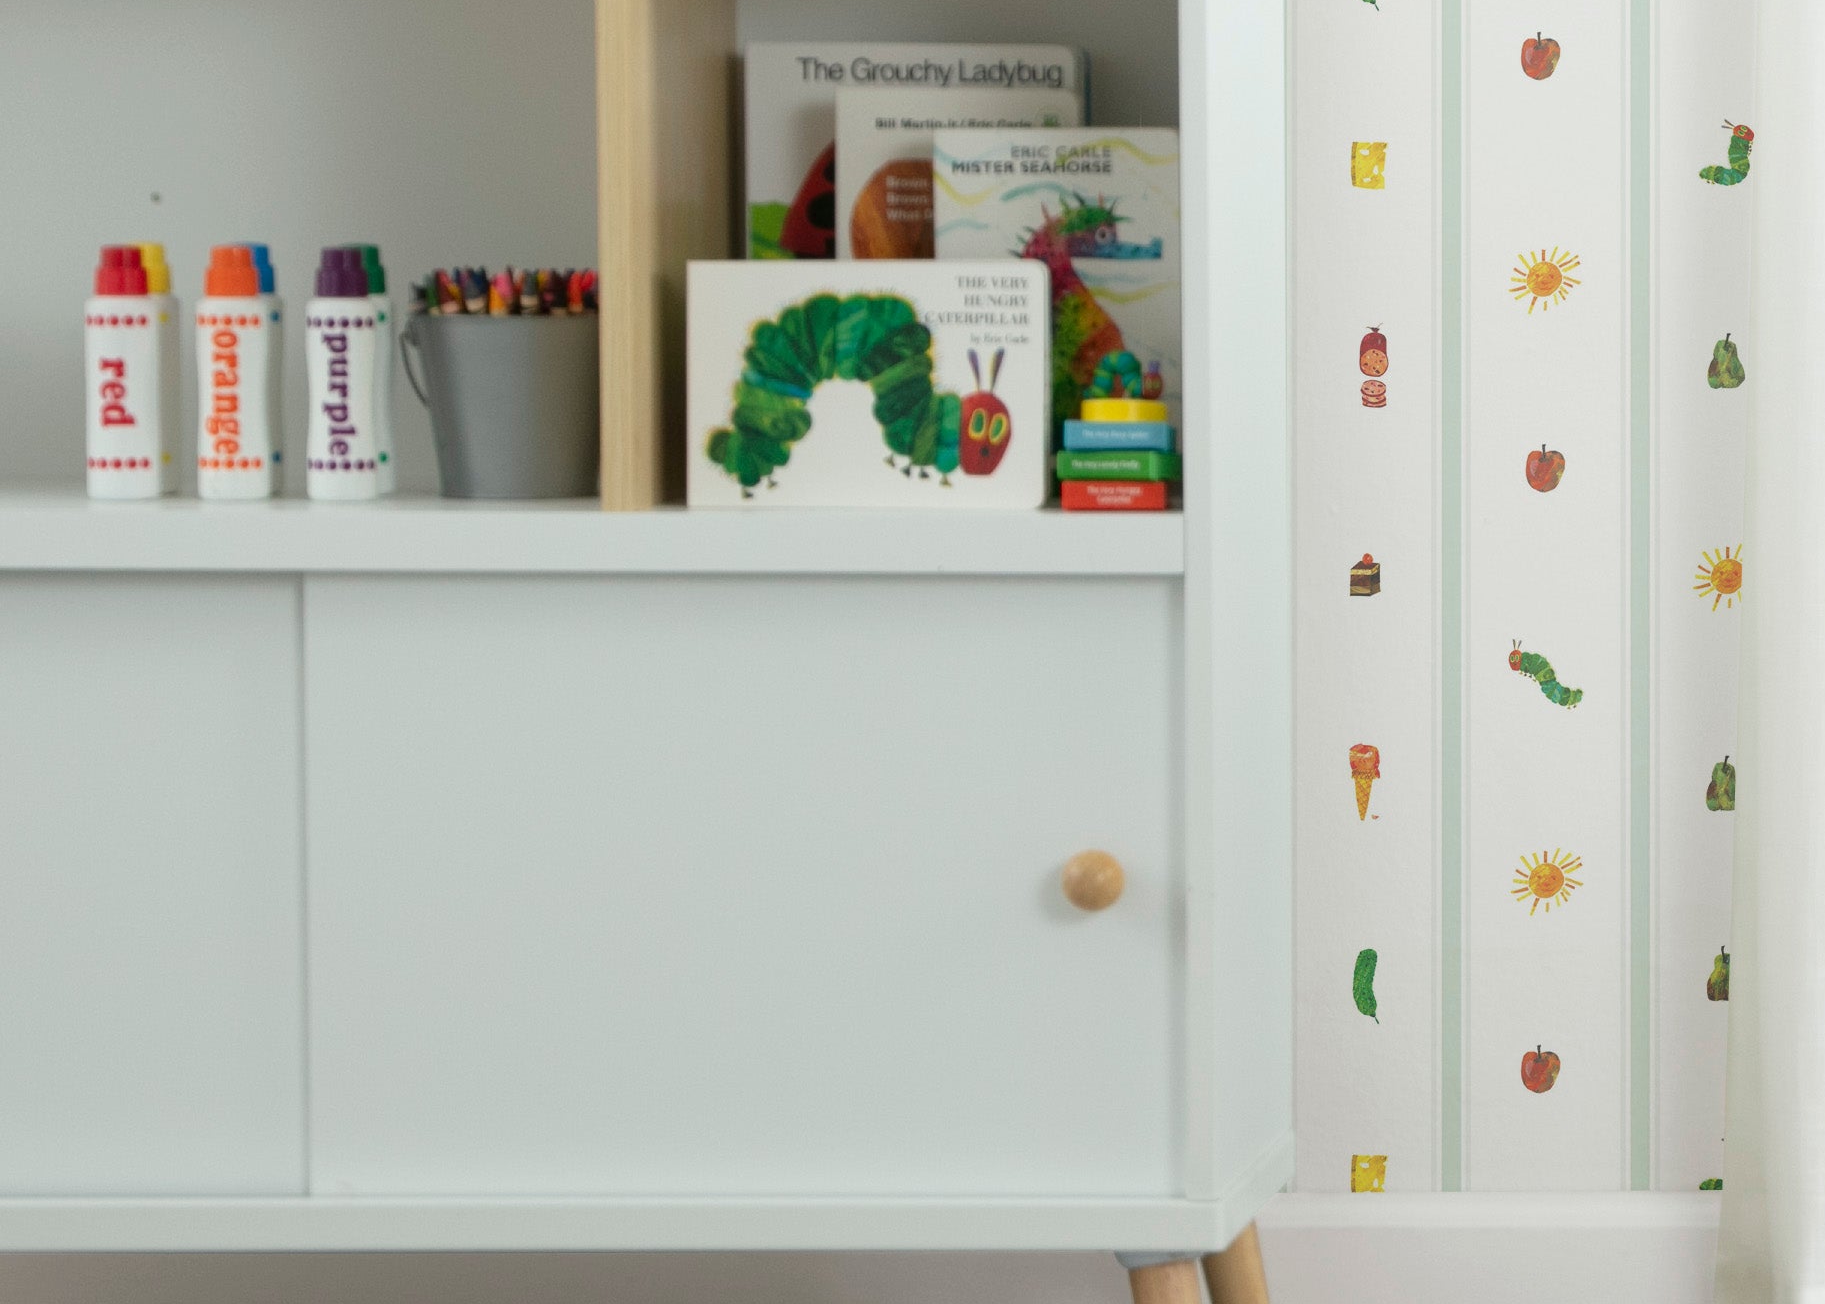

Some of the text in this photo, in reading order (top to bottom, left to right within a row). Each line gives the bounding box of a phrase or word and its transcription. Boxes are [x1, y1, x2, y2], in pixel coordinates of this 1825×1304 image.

[797, 56, 1062, 87] The Grouchy Ladybug
[1010, 146, 1112, 159] ERIC CARLE
[951, 161, 1112, 173] MISTER SEAHORSE
[957, 277, 1028, 288] THE VERY
[964, 295, 1028, 306] HUNGRY
[924, 312, 1029, 324] CATERPILLAR
[100, 358, 135, 427] red
[206, 330, 240, 455] orange
[322, 332, 356, 456] purple
